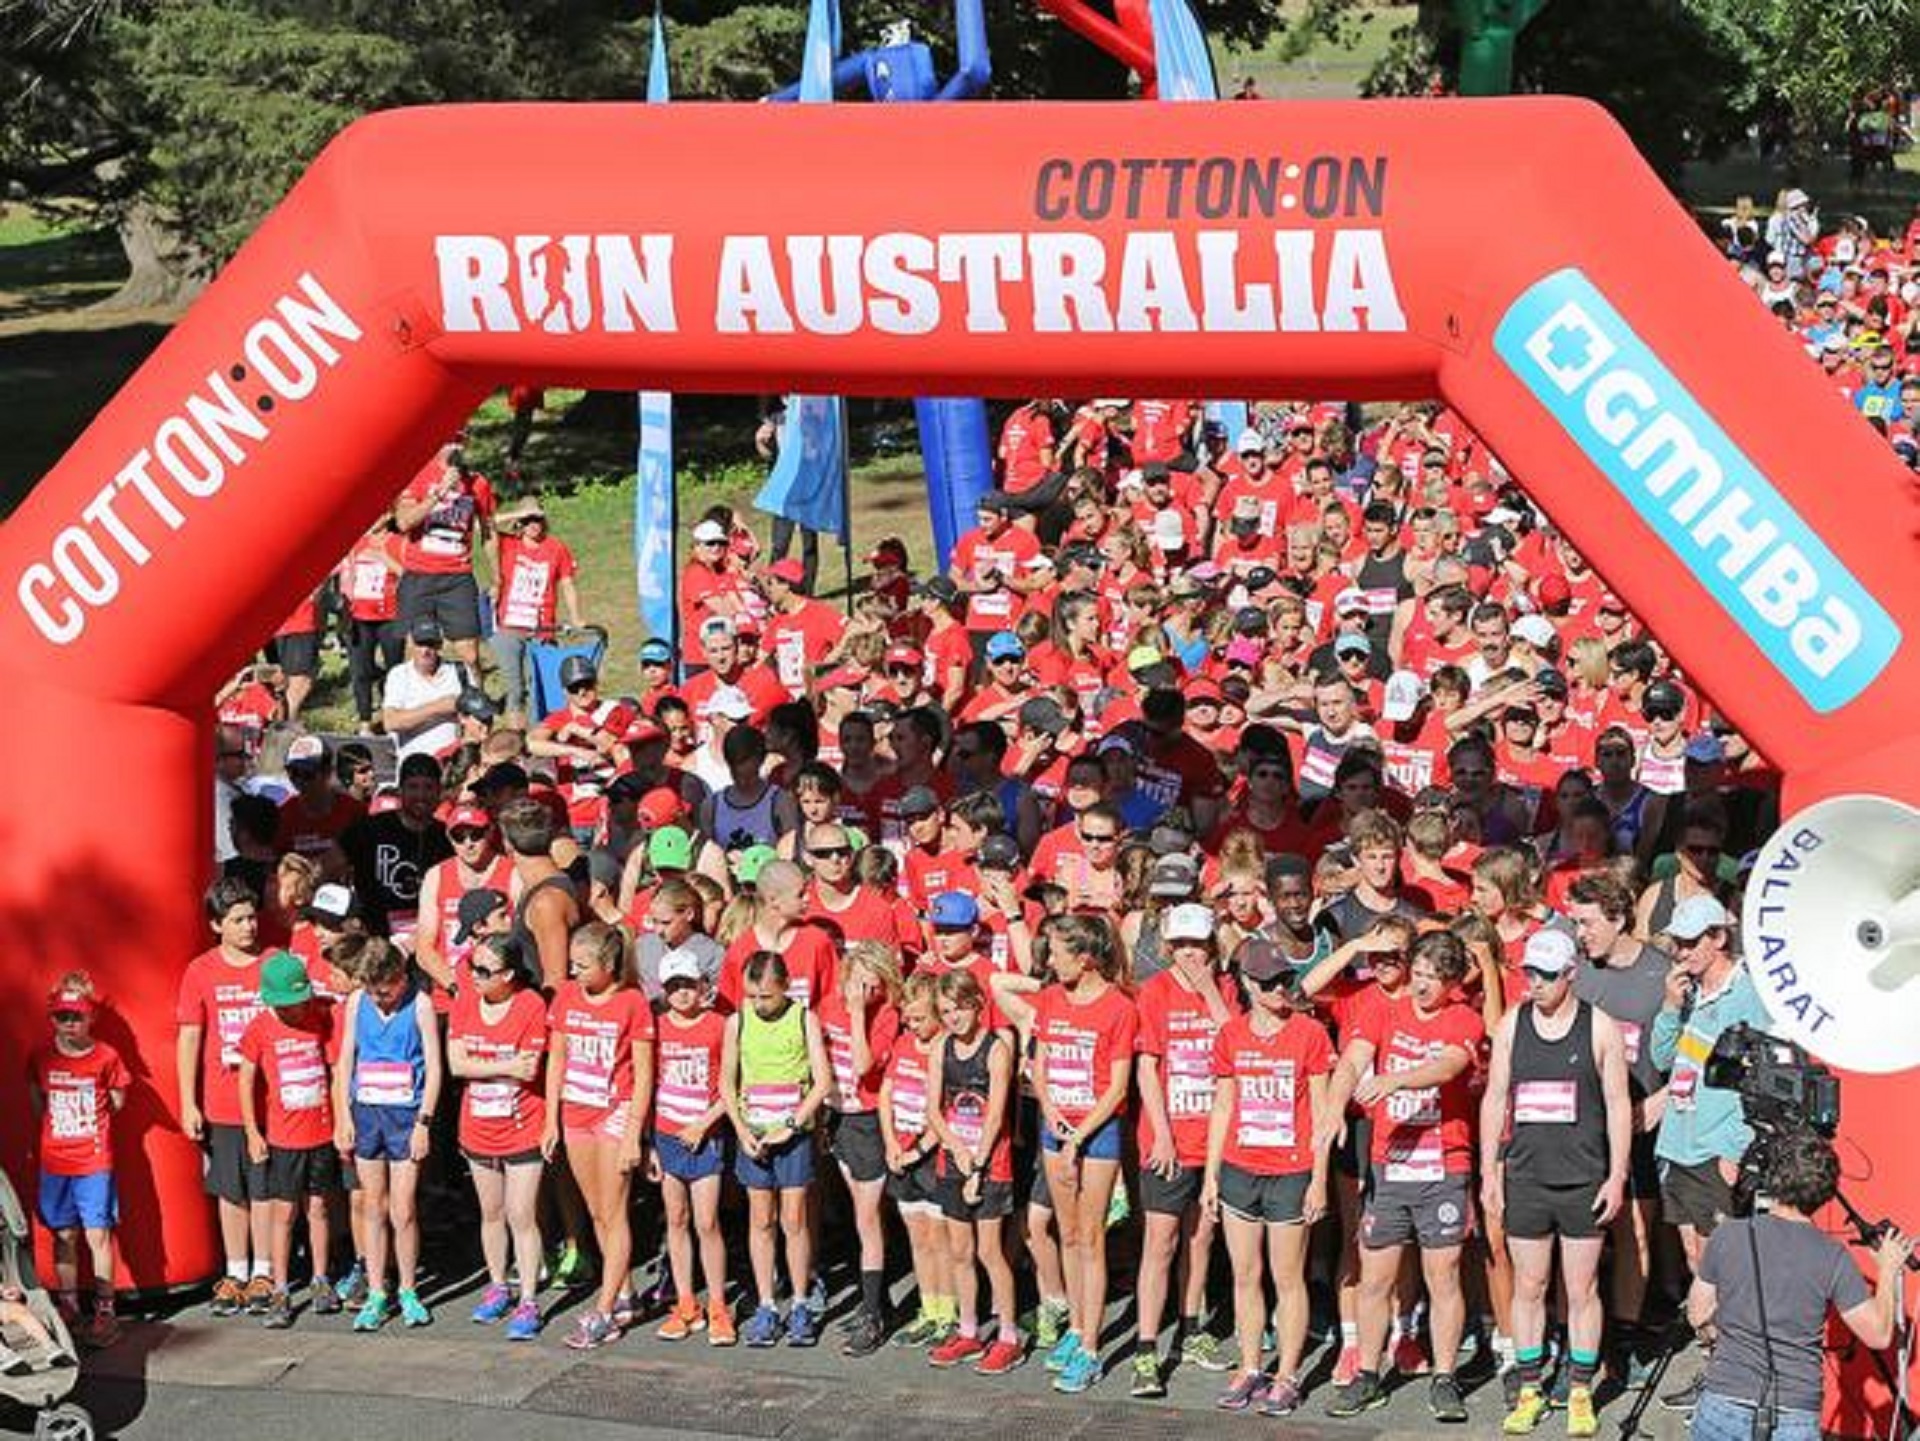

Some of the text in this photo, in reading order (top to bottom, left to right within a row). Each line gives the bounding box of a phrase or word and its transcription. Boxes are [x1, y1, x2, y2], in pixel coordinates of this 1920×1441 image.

[1035, 156, 1388, 221] COTTON:ON
[434, 230, 1406, 335] RUN AUSTRALIA
[18, 272, 363, 645] COTTON:ON
[1758, 828, 1835, 1033] BALLARAT
[1240, 1075, 1295, 1101] RUN
